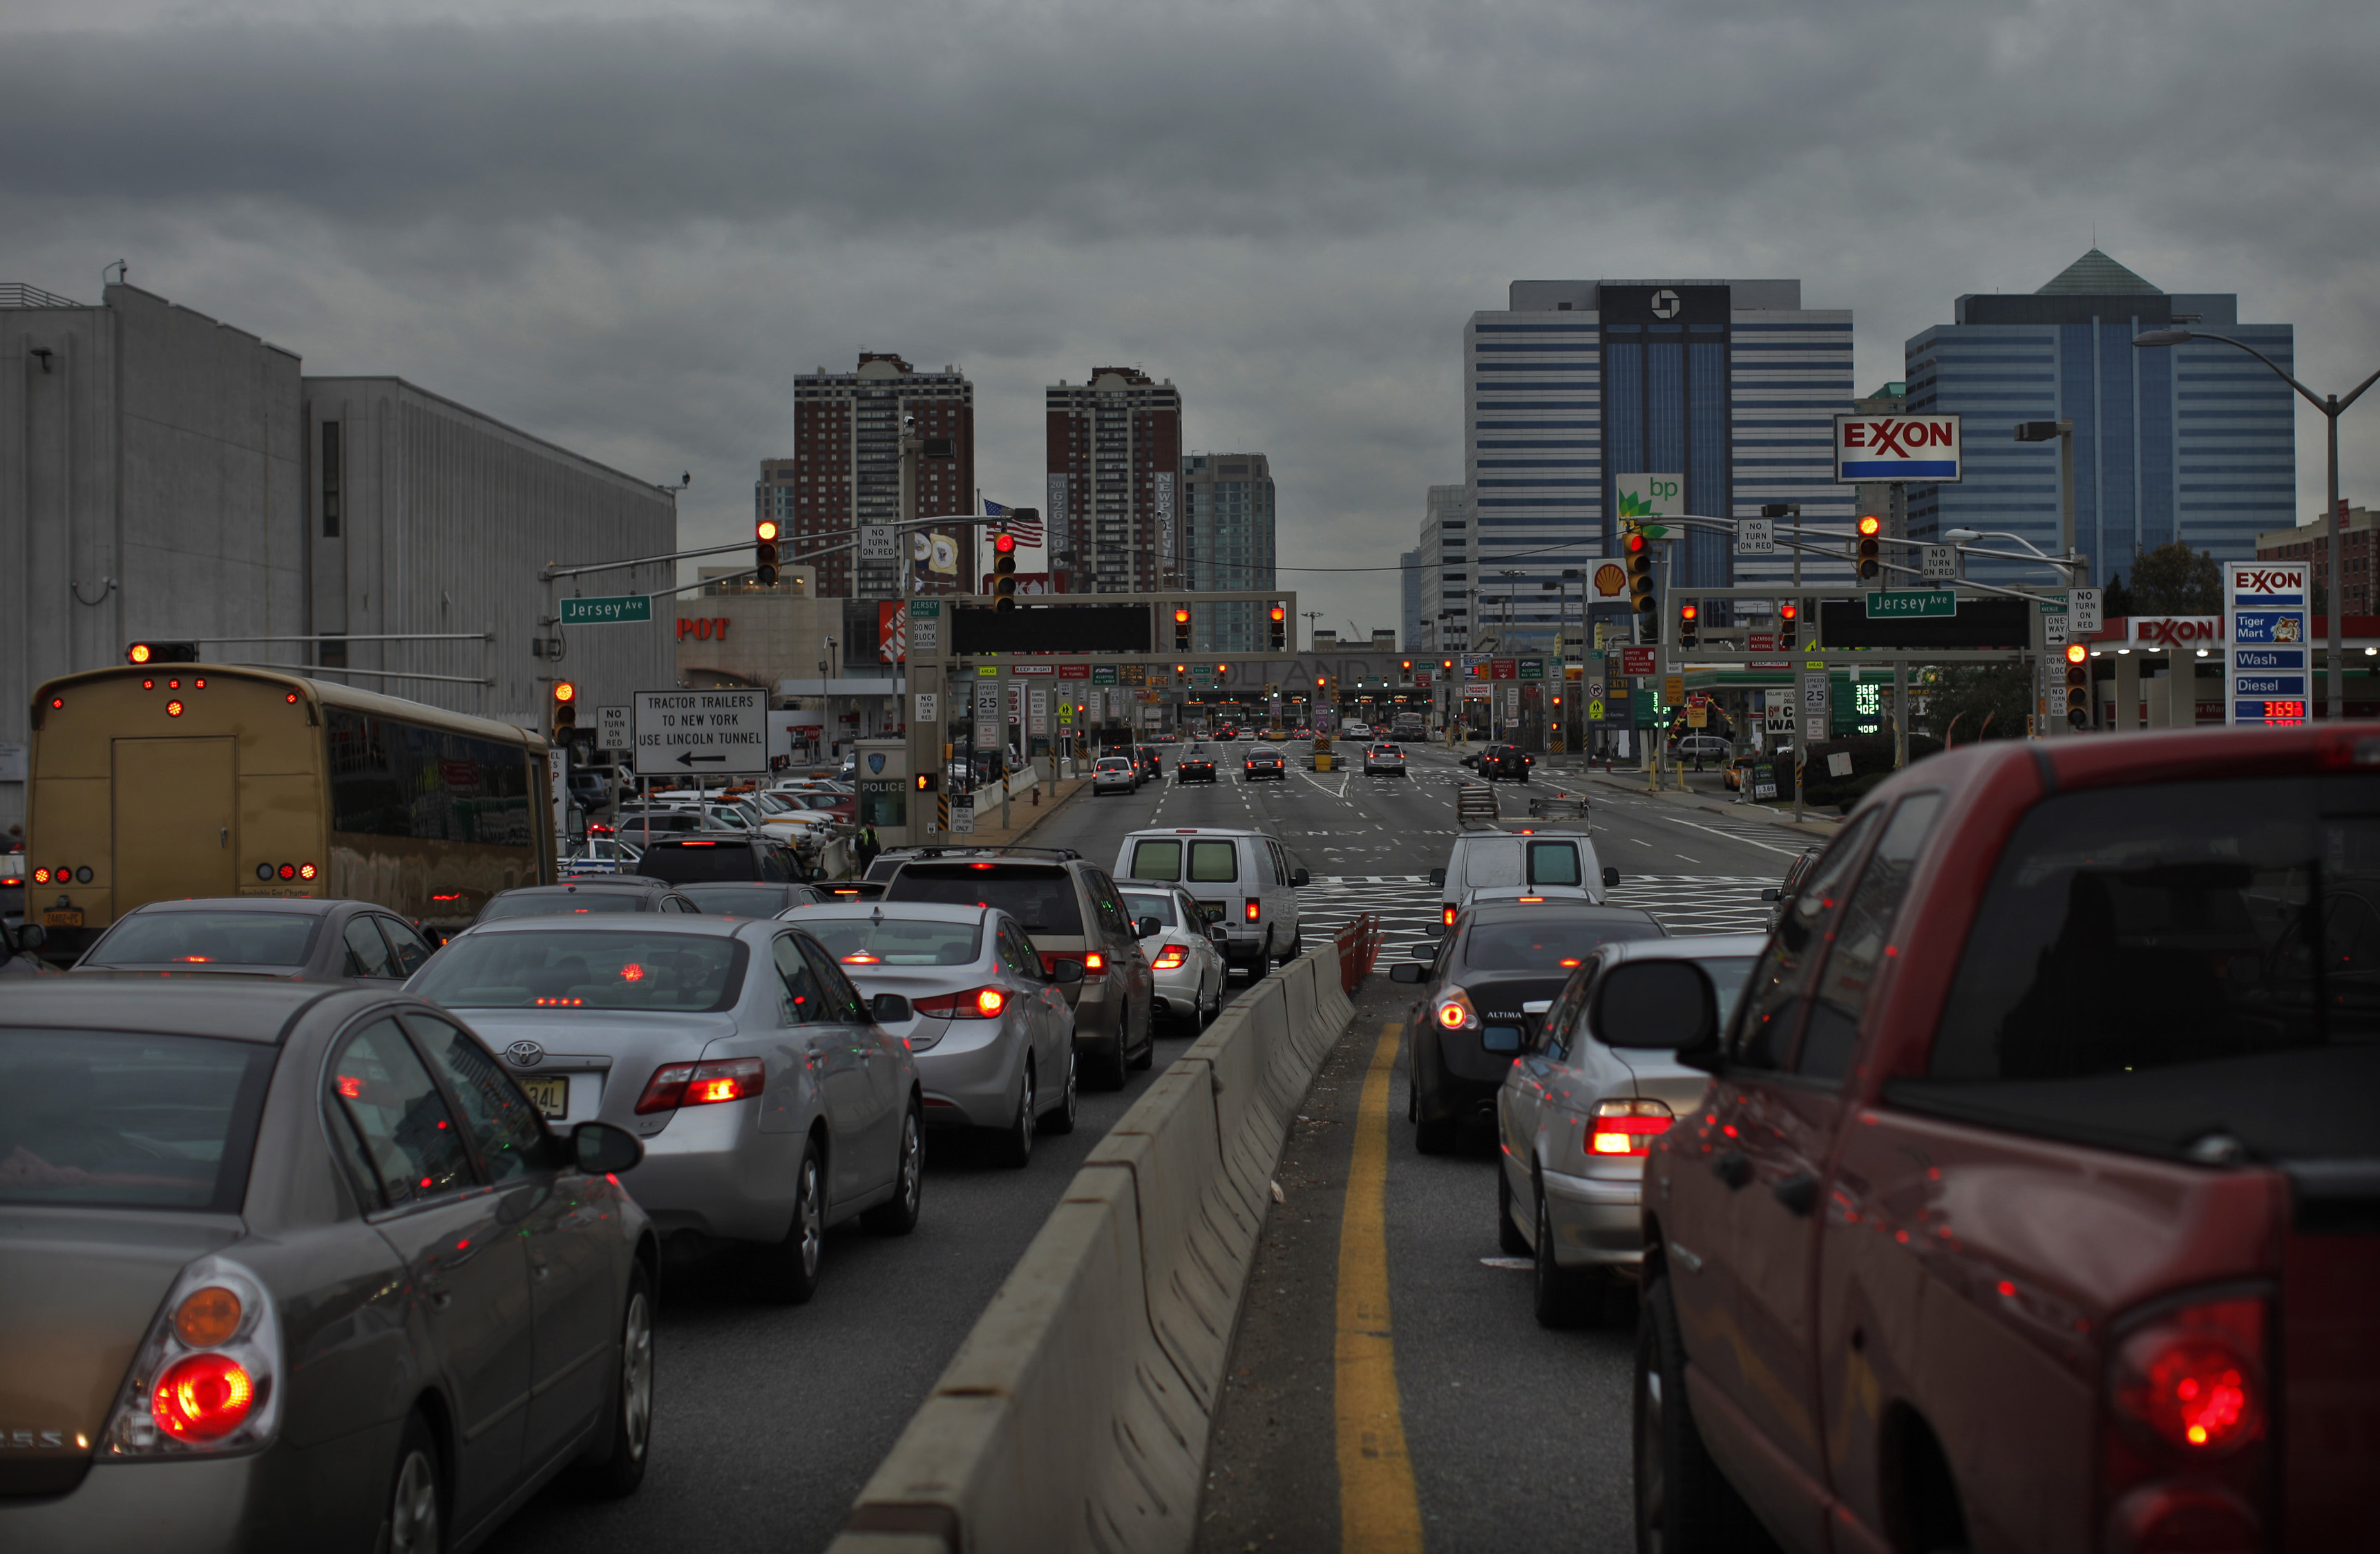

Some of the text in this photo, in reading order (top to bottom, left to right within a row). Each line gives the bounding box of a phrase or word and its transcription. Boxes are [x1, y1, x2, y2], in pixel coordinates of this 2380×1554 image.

[1844, 419, 1952, 458] EXXON
[1650, 477, 1677, 501] bp
[2236, 570, 2301, 594] EXXON
[569, 601, 642, 618] Jersey Ave
[1875, 595, 1948, 612] Jersey Ave
[2238, 617, 2265, 628] Tiger
[676, 618, 730, 640] POT
[2138, 618, 2213, 647] EXXON
[2238, 627, 2264, 638] Mart
[2238, 653, 2277, 665] Wash
[2238, 680, 2278, 692] Diesel
[648, 697, 754, 708] TRACTOR TRAILERS
[1807, 692, 1824, 701] 25
[979, 698, 997, 708] 25
[663, 714, 739, 726] TO NEW YORK
[639, 732, 762, 746] USE LINCOLN TUNNEL
[862, 782, 905, 792] POLICE
